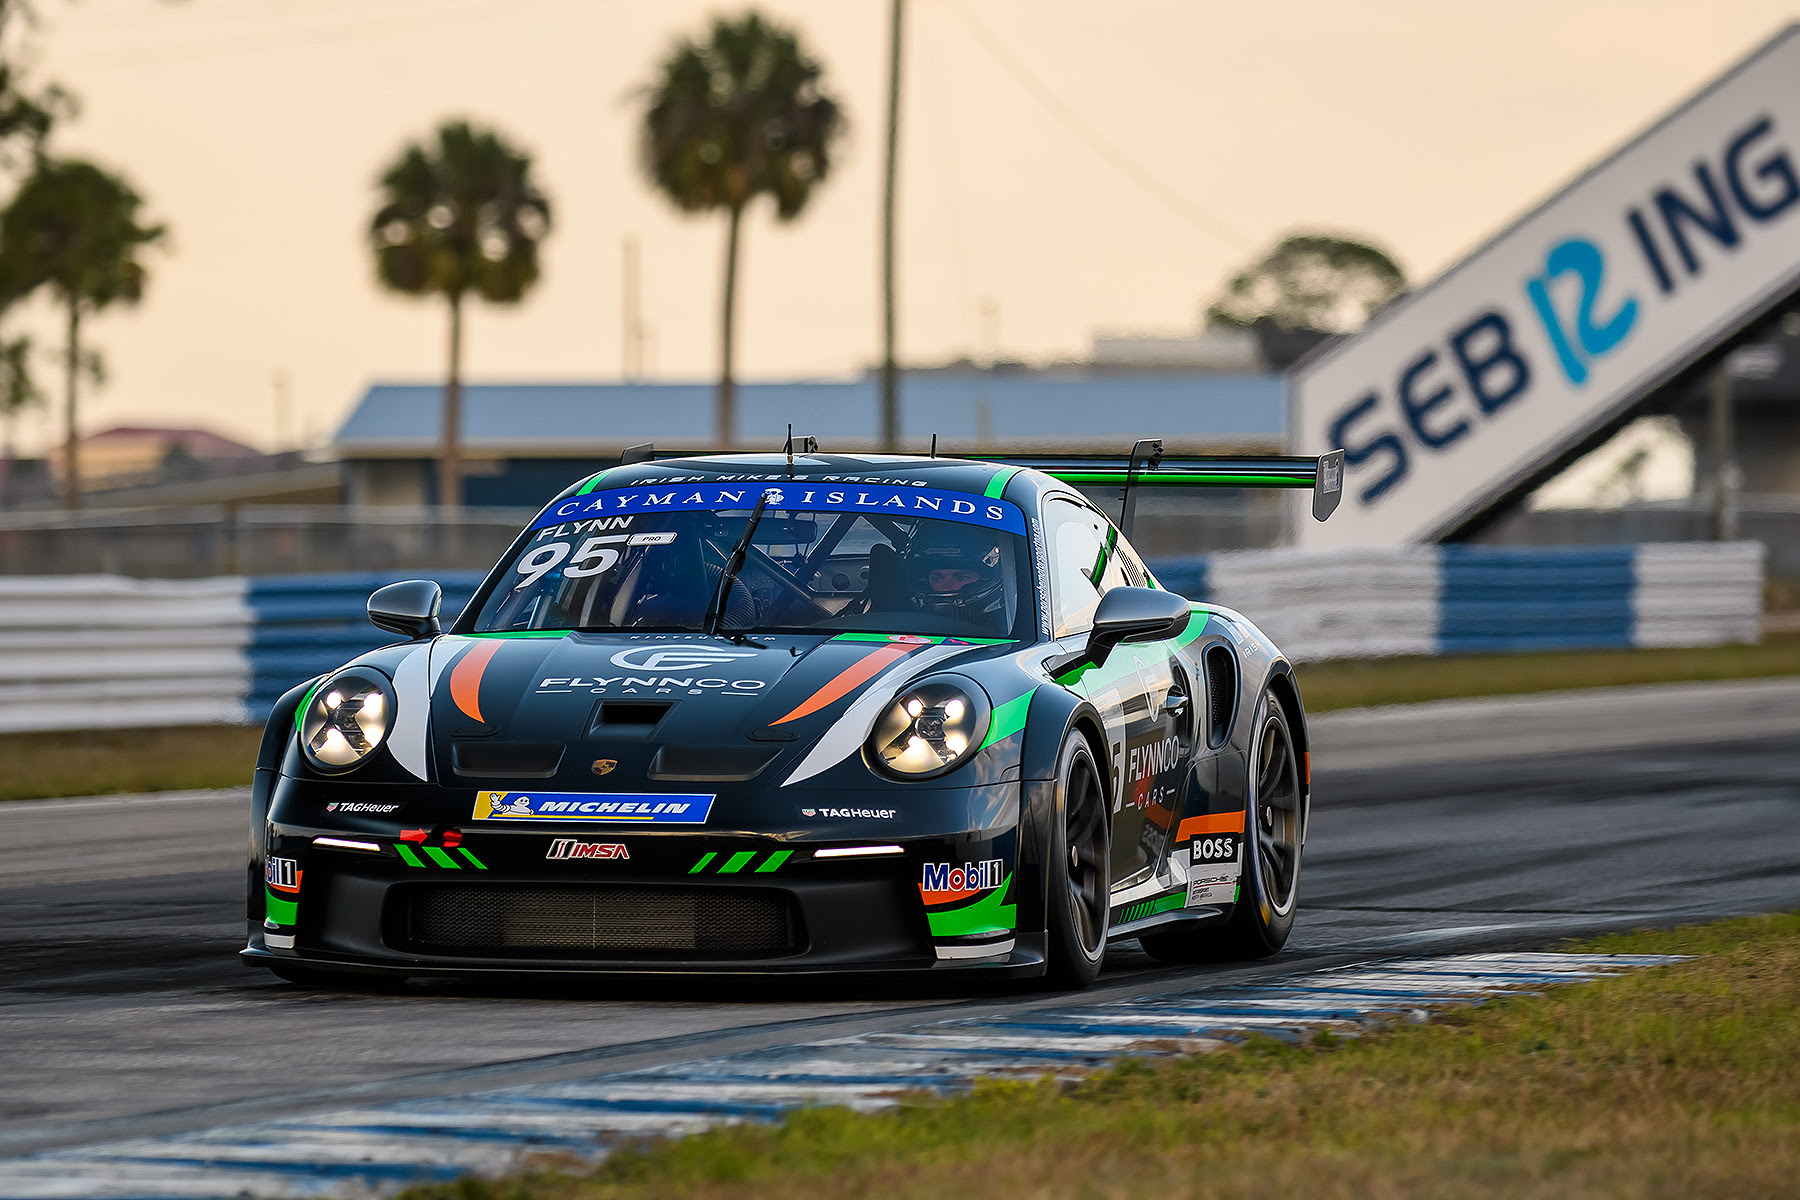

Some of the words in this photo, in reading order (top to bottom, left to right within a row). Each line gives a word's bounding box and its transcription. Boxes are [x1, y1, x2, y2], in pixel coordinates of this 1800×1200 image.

[630, 476, 705, 486] IRISH
[822, 475, 928, 487] RACING
[556, 490, 746, 516] CAYMAN
[801, 491, 1004, 521] ISLANDS
[536, 516, 634, 542] FLYNN
[513, 533, 630, 592] 95
[539, 677, 766, 690] FLYNNCO
[1128, 735, 1180, 783] FLYNNCO
[538, 801, 691, 814] MICHELIN
[1137, 786, 1165, 811] CARS
[571, 843, 630, 859] IMSA
[1193, 838, 1233, 860] BOSS
